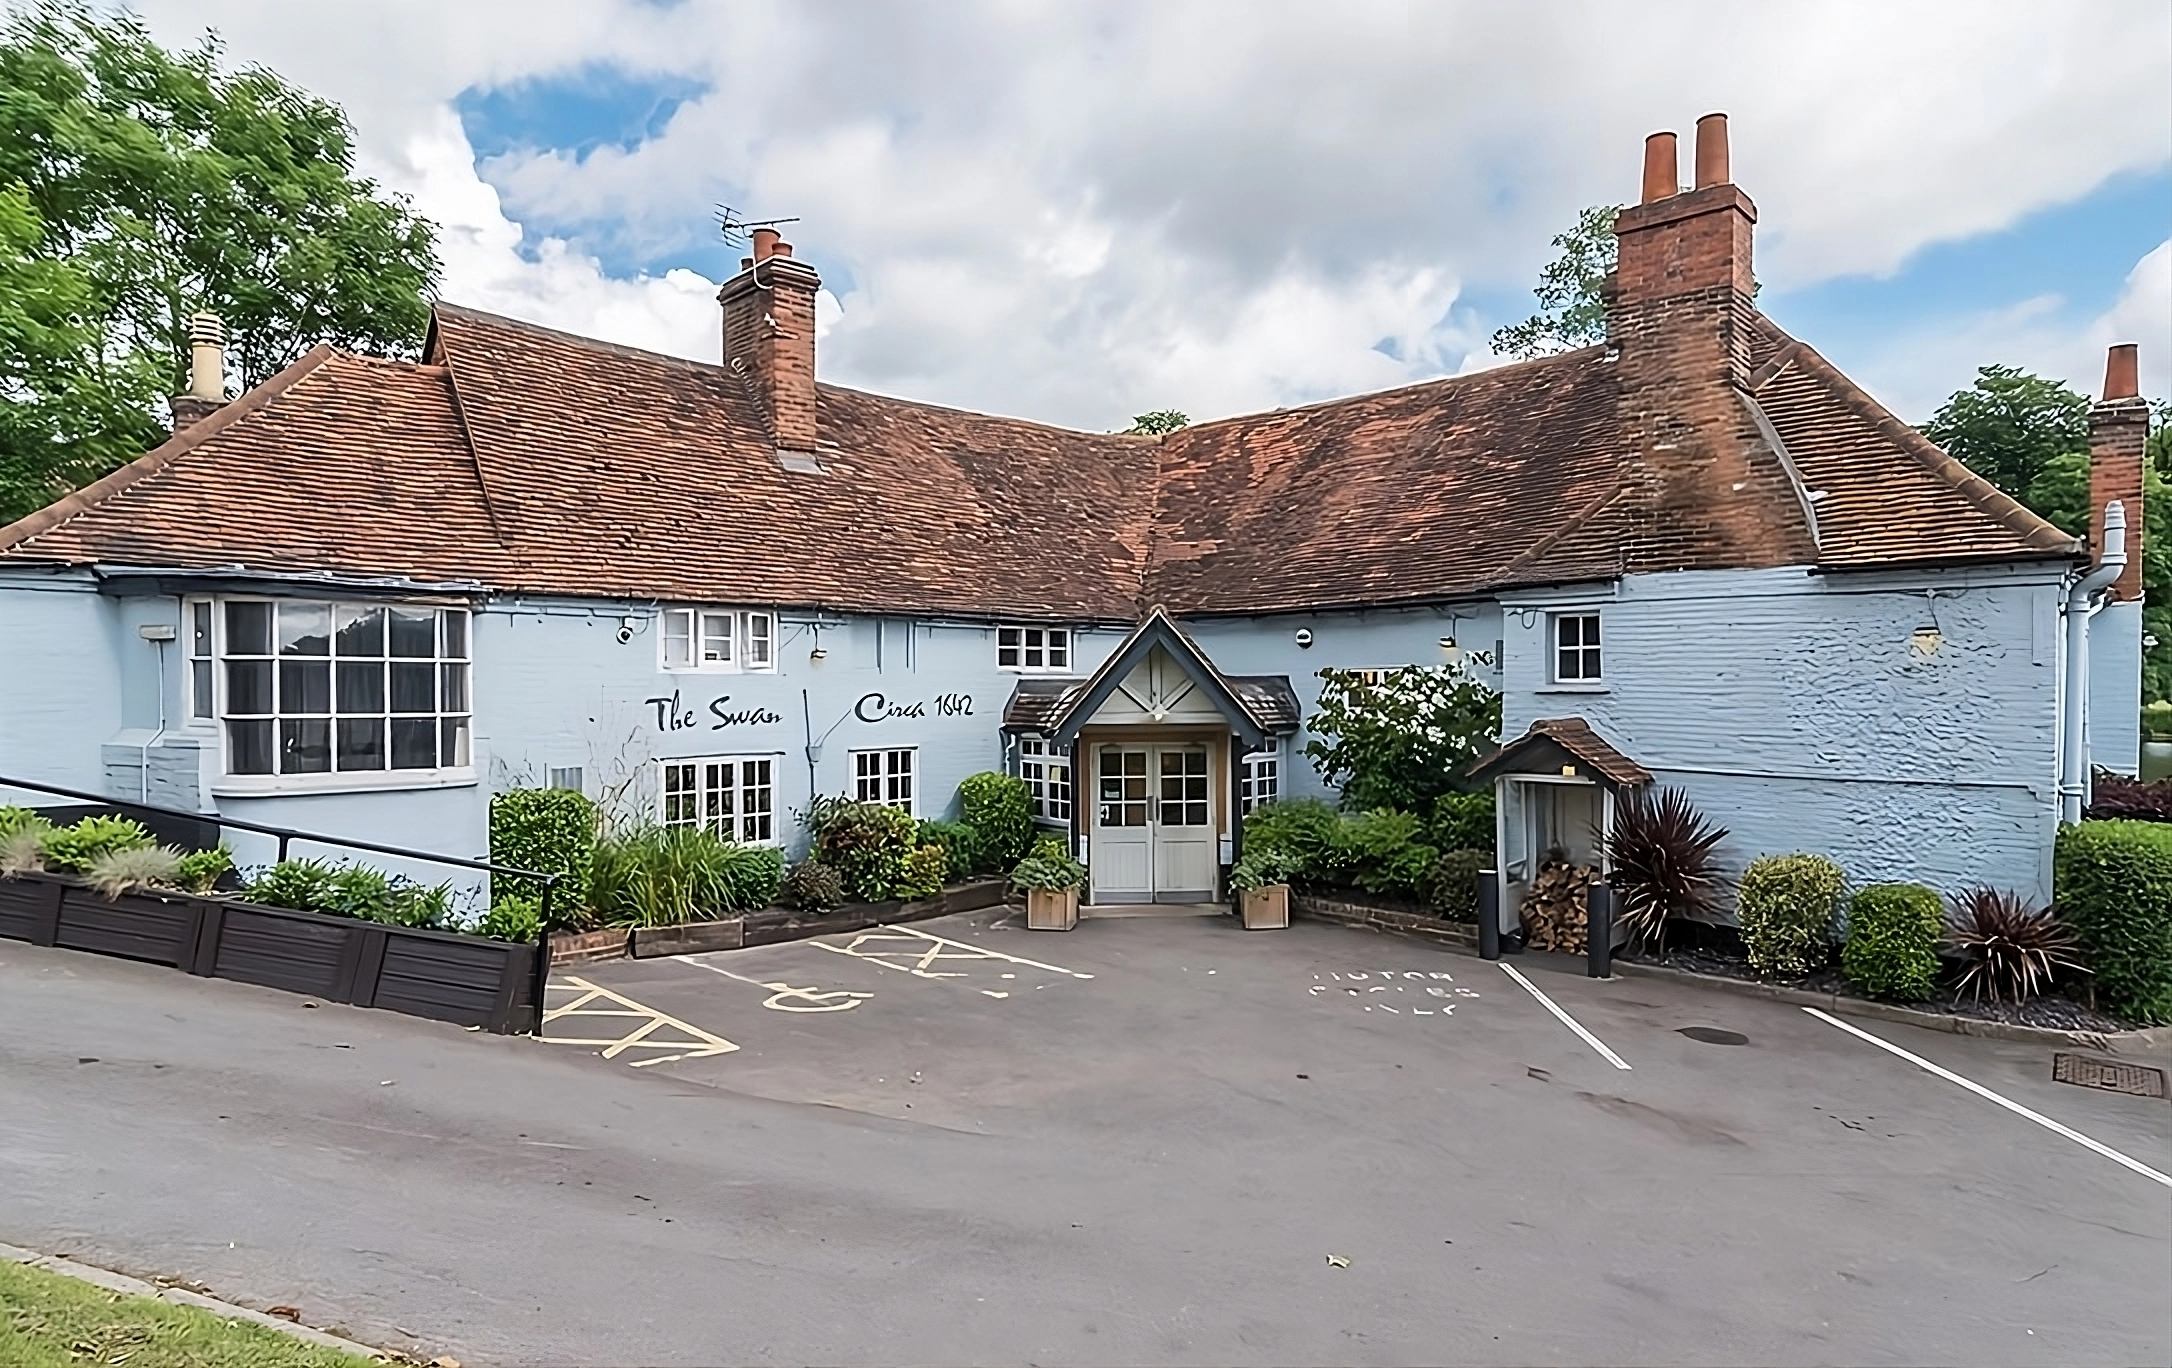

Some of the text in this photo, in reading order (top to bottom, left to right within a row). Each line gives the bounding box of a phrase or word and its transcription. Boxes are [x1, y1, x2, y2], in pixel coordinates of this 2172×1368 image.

[645, 689, 783, 731] The Swan
[855, 692, 974, 722] Circa 1642
